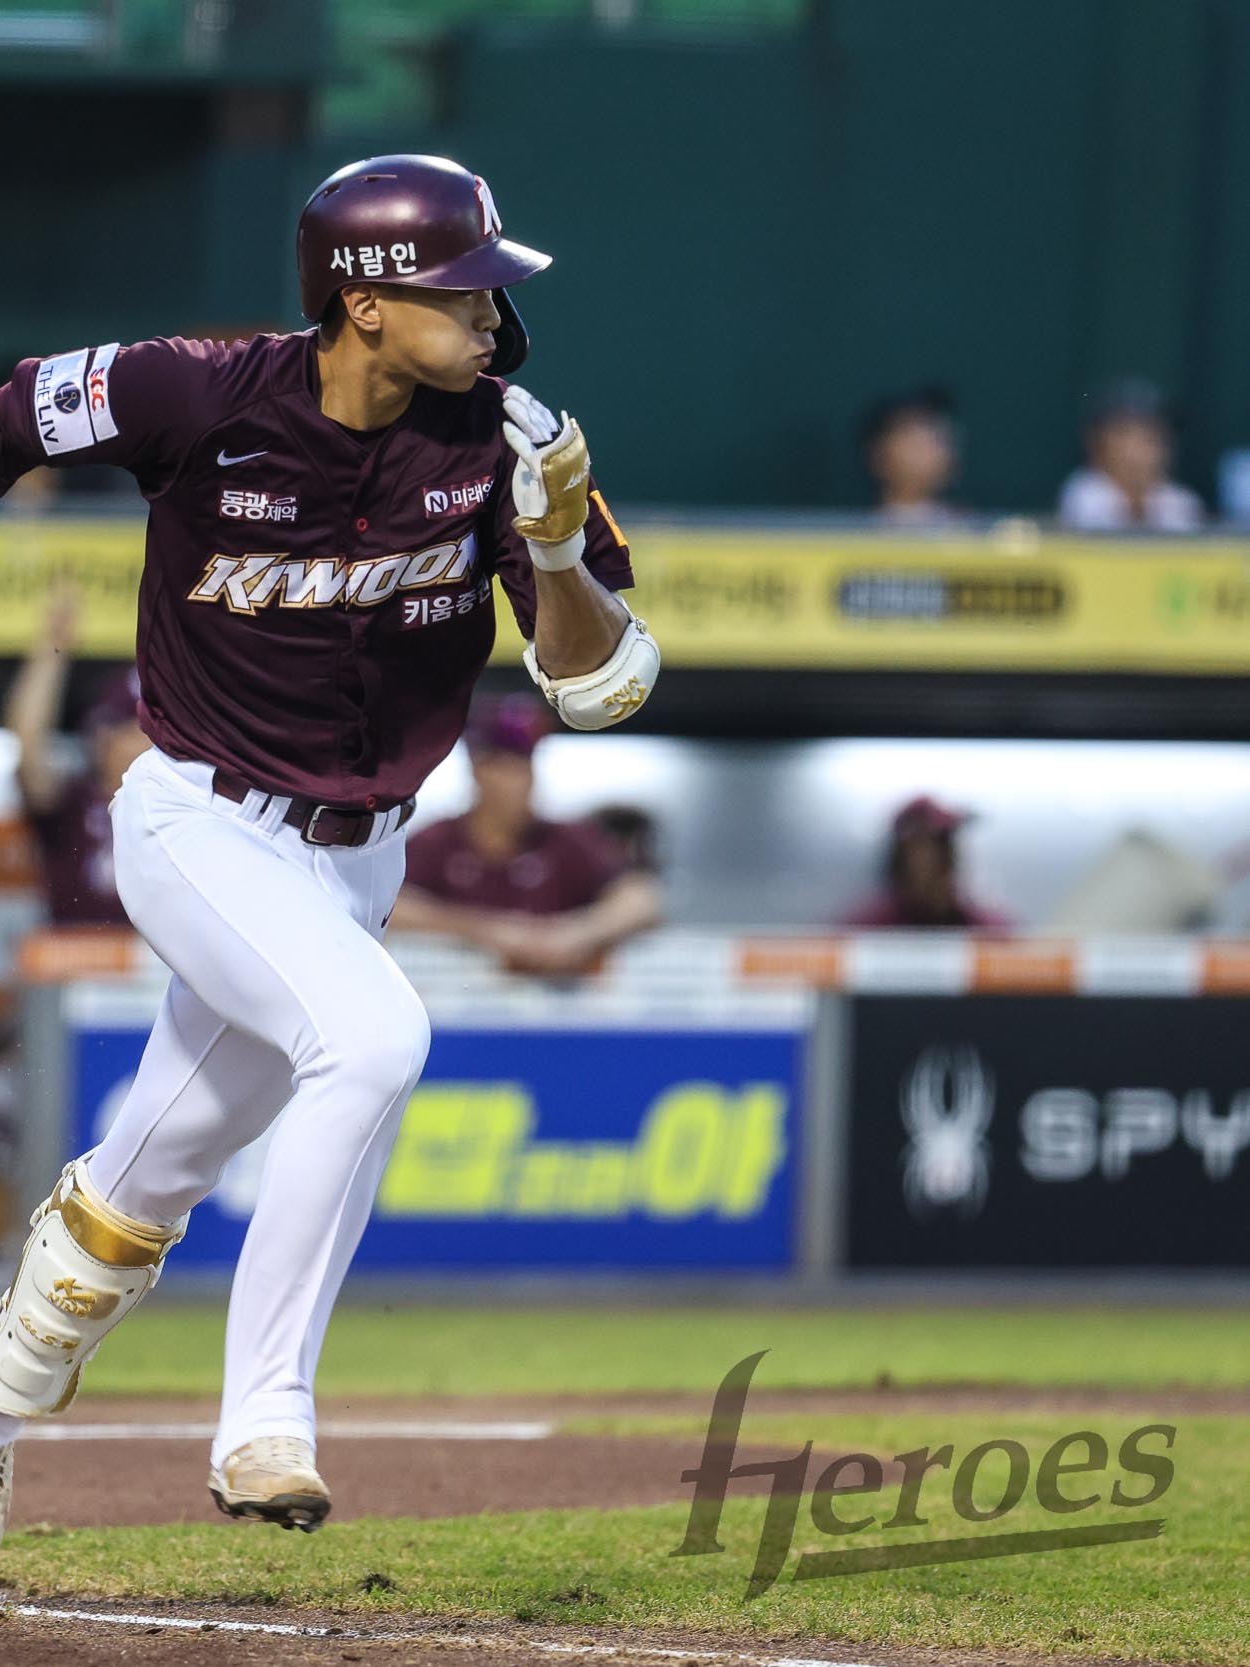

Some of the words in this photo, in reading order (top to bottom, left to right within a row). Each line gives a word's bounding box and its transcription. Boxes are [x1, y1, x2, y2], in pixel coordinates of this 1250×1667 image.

[330, 241, 417, 277] 사람인
[37, 366, 53, 401] THE
[38, 405, 59, 442] LIV
[220, 489, 298, 522] 동광제약
